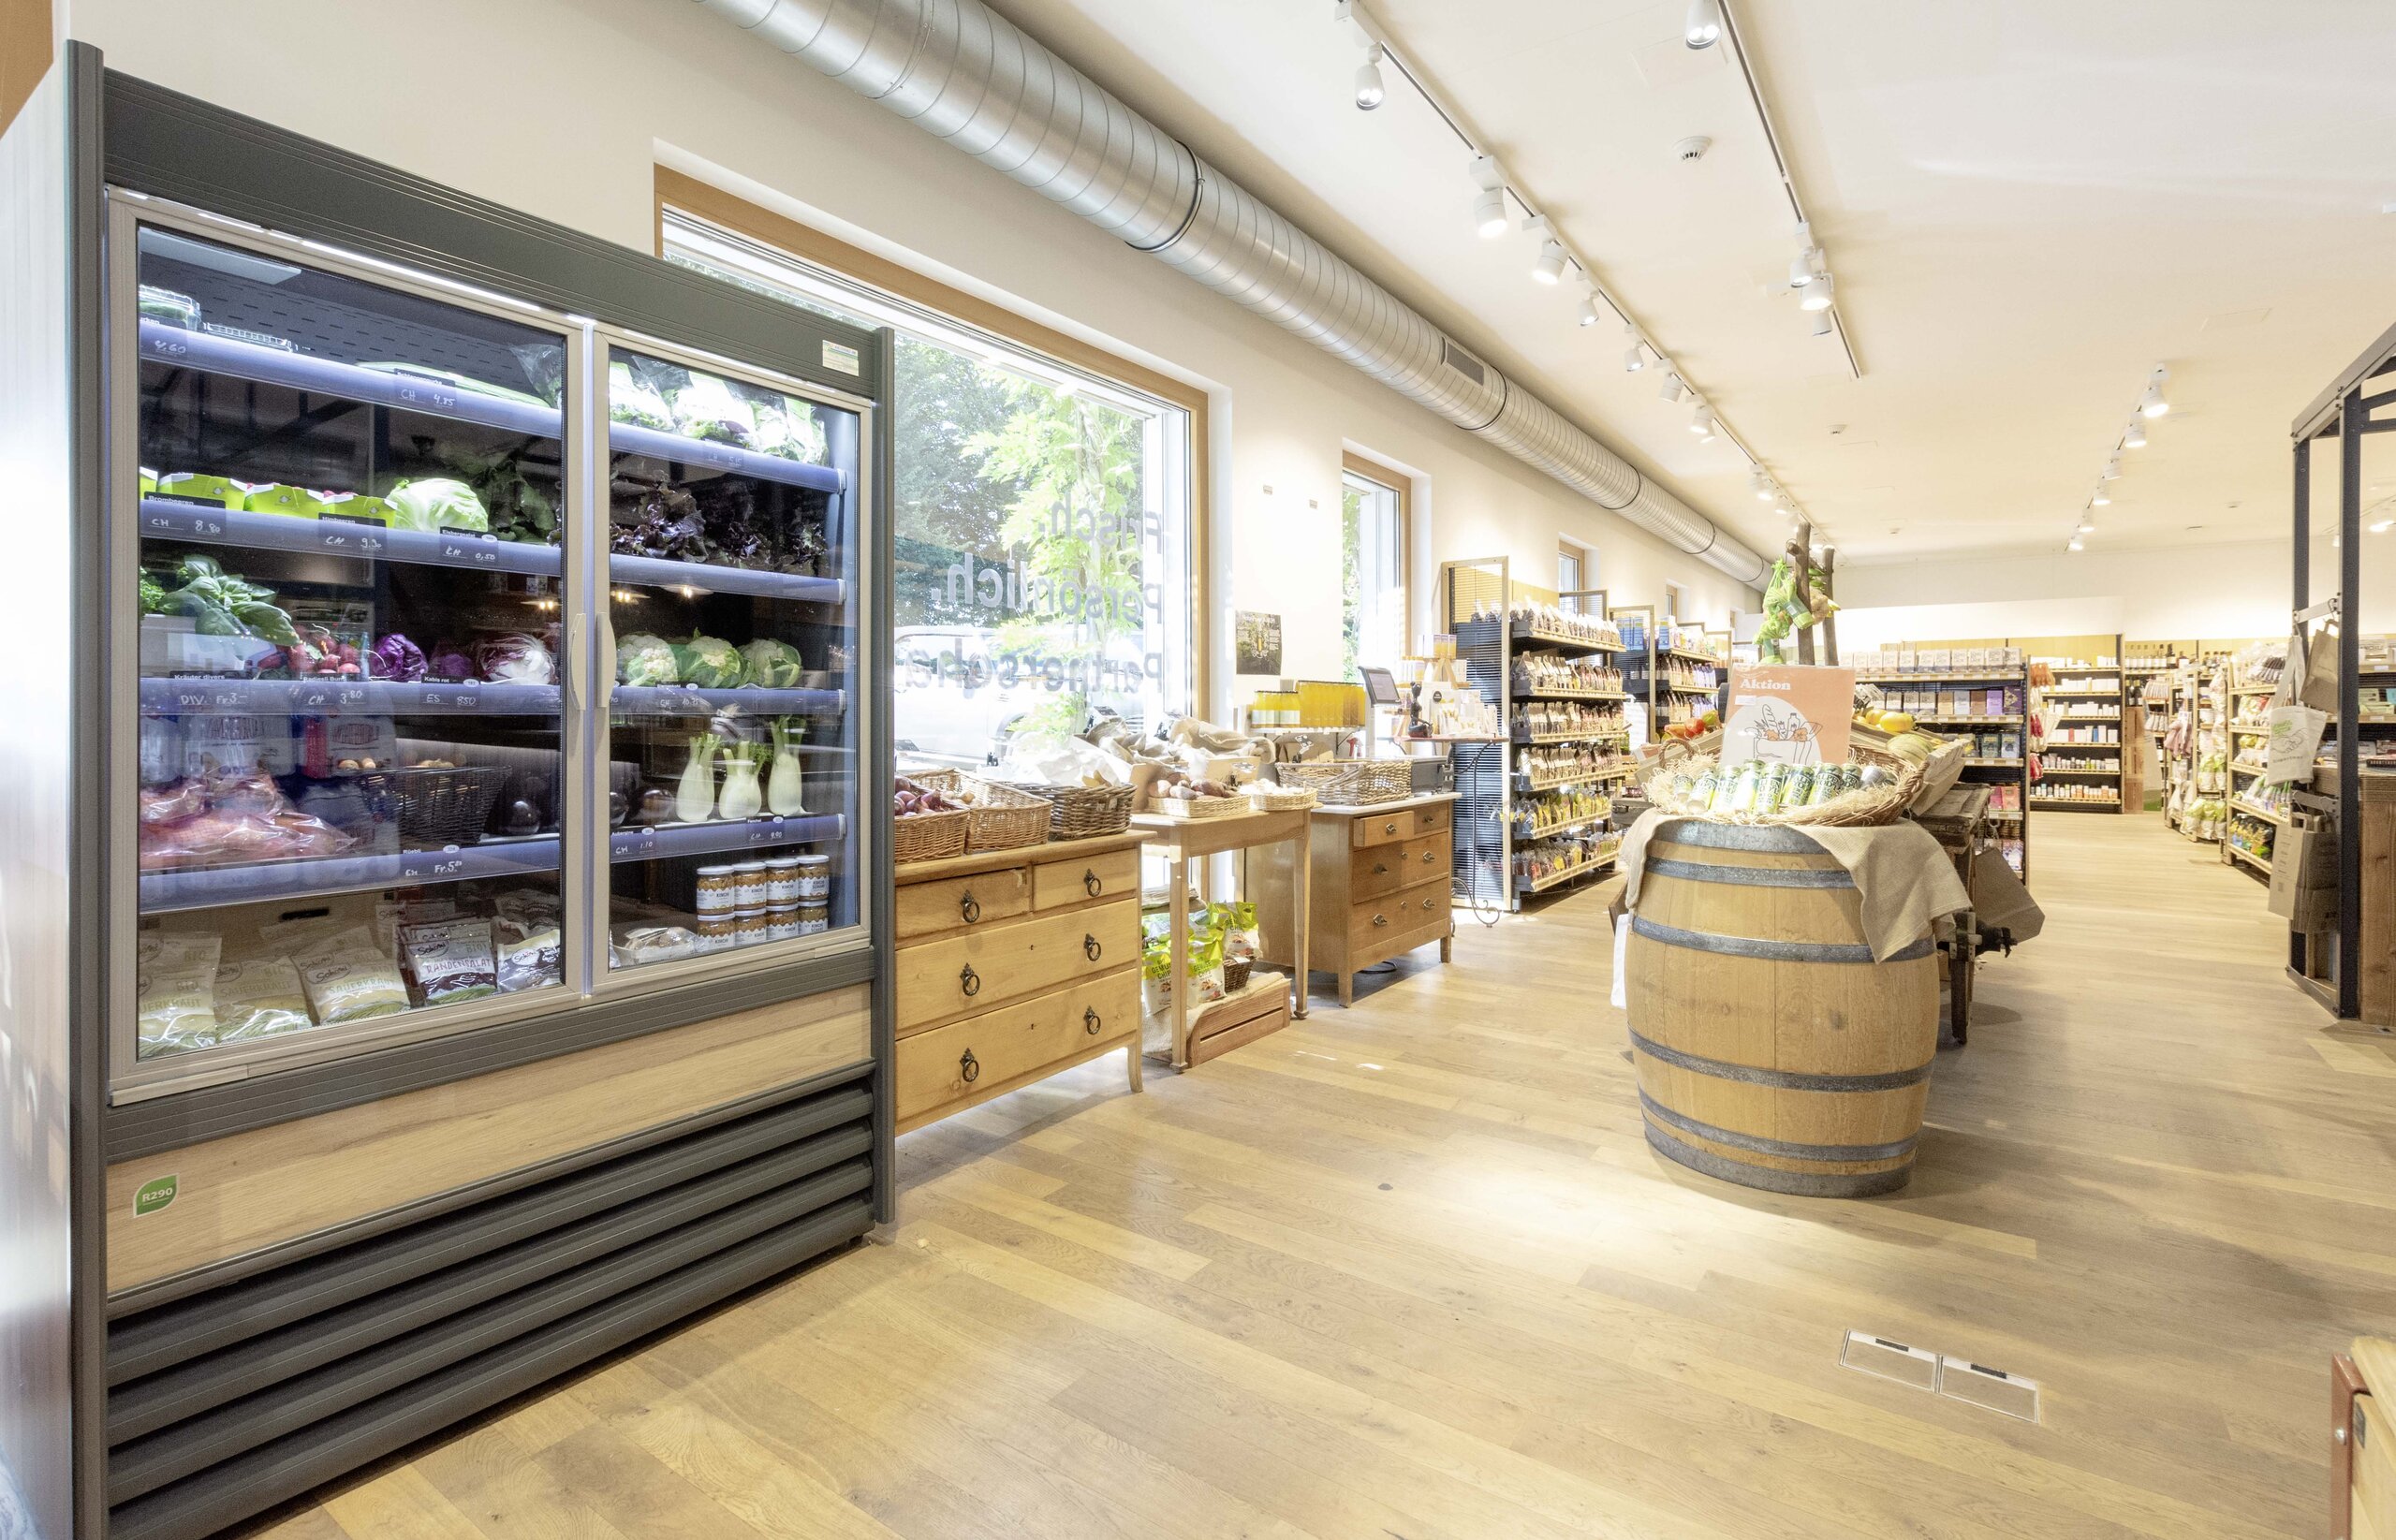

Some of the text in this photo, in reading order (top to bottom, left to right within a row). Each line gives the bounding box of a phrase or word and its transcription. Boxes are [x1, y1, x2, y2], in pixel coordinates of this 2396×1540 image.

[401, 389, 417, 402] CH
[152, 519, 169, 527] CH
[1740, 679, 1791, 691] Aktion
[308, 695, 325, 706] CH
[426, 959, 492, 974] RANDENSALAT
[142, 1187, 173, 1202] R290
